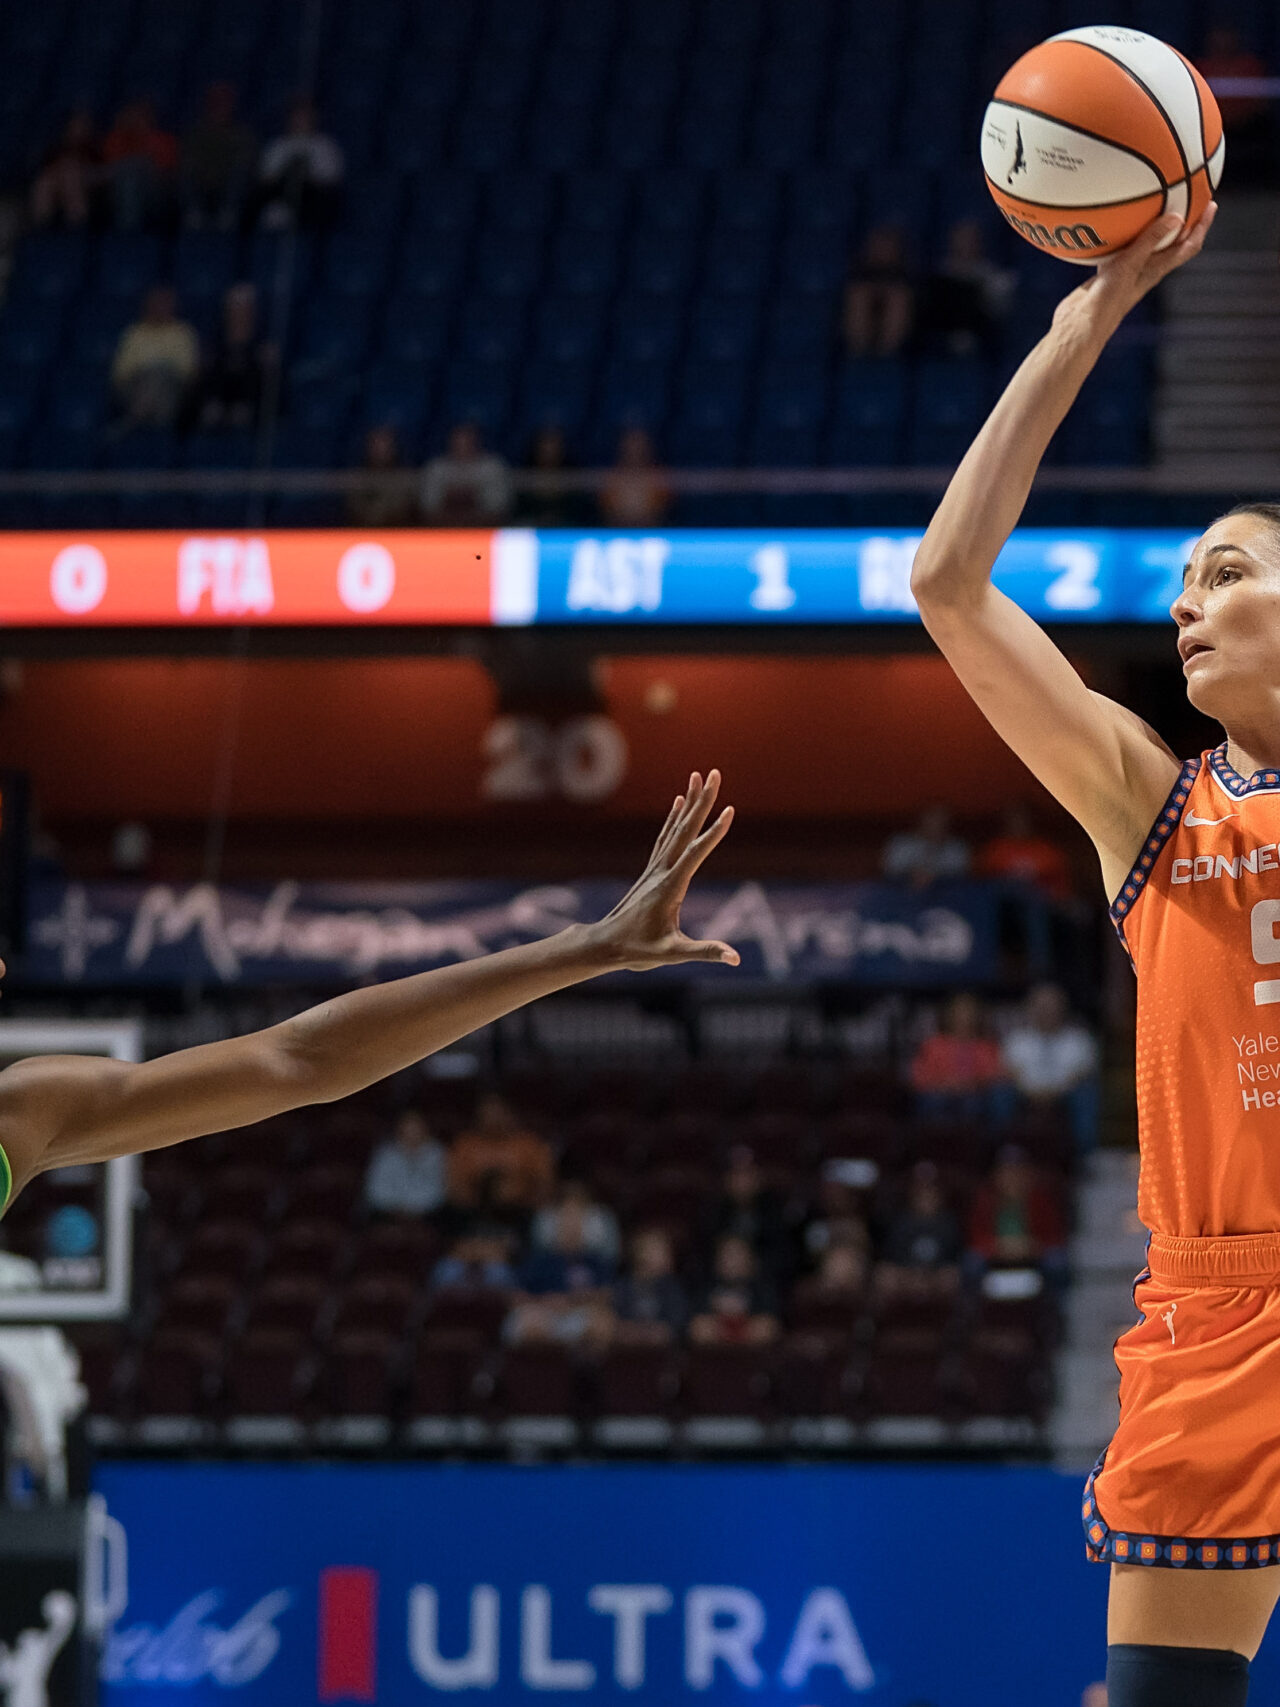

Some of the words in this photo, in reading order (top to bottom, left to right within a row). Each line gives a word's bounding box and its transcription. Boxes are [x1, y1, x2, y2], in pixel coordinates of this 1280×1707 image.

[50, 543, 108, 613] 0
[337, 541, 396, 613] 0
[566, 537, 670, 613] AST
[751, 543, 795, 611] 1
[1044, 542, 1100, 611] 2
[482, 714, 628, 800] 20
[1232, 1031, 1280, 1057] Yale
[408, 1583, 876, 1692] ULTRA
